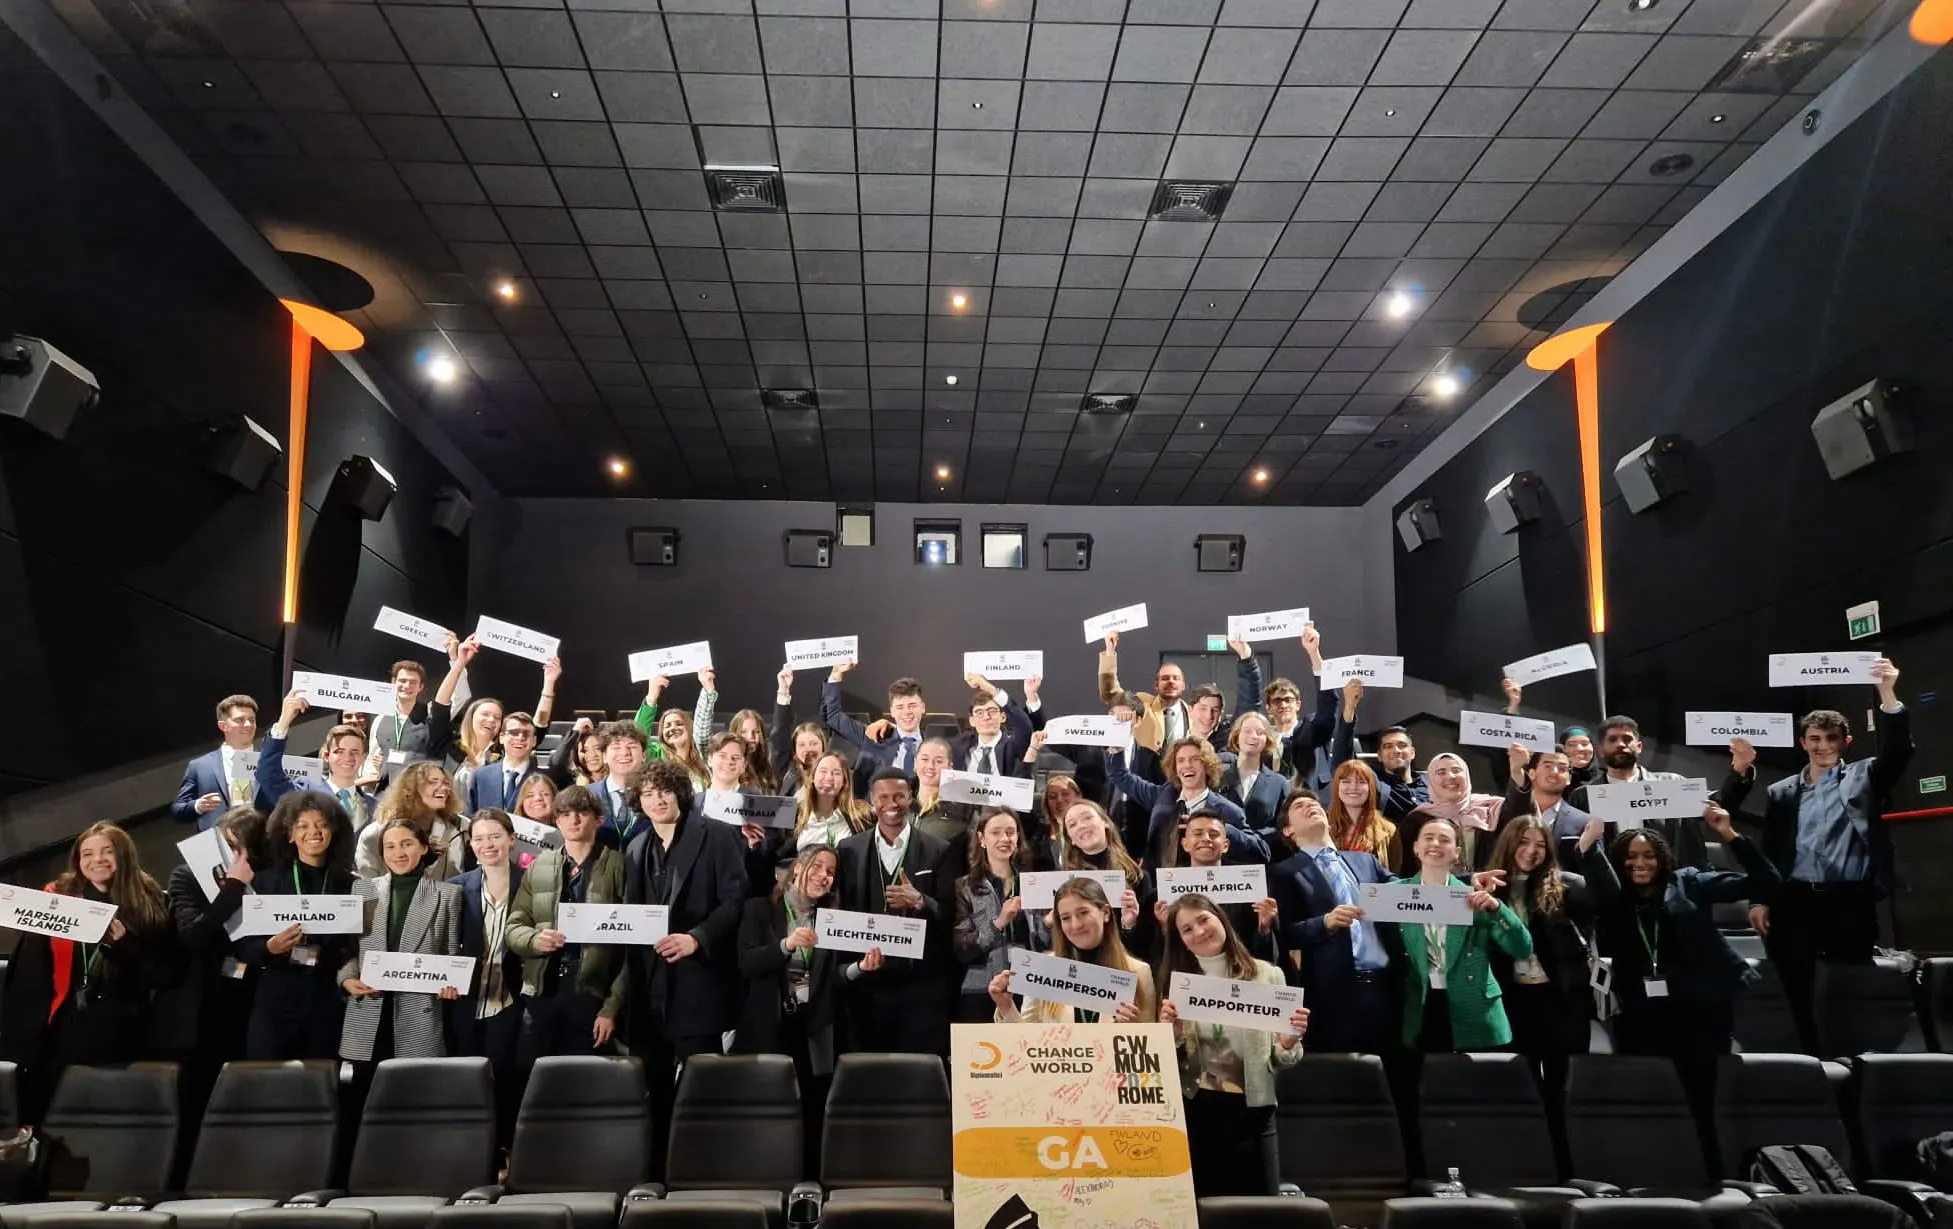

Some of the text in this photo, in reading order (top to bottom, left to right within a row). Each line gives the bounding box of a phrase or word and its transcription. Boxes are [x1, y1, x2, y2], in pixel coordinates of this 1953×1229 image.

[399, 623, 428, 639] GREECE
[1249, 623, 1288, 633] NORWAY
[791, 649, 854, 661] UNITED KINGDOM
[658, 659, 684, 669] SPAIN
[1341, 669, 1376, 678] FRANCE
[1800, 666, 1850, 676] AUSTRIA
[317, 688, 371, 703] BULGARIA
[1064, 728, 1105, 737] SWEDEN
[1479, 727, 1538, 742] COSTA RICA
[1711, 727, 1768, 737] COLOMBIA
[969, 786, 1003, 798] JAPAN
[1630, 798, 1669, 808] EGYPT
[724, 807, 776, 818] AUSTRALIA
[1171, 883, 1253, 894] SOUTH AFRICA
[1396, 902, 1434, 911] CHINA
[14, 907, 81, 928] MARSHALL
[273, 913, 336, 921] THAILAND
[16, 916, 70, 934] ISLANDS
[826, 928, 913, 945] LIECHTENSTEIN
[382, 970, 448, 982] ARGENTINA
[1025, 972, 1117, 1001] CHAIRPERSON
[1189, 996, 1281, 1017] RAPPORTEUR
[1113, 1035, 1148, 1055] CW
[1026, 1047, 1095, 1058] CHANGE
[1029, 1062, 1094, 1074] WORLD
[1114, 1054, 1161, 1073] MUN
[1116, 1073, 1163, 1088] 2023
[1118, 1087, 1165, 1105] ROME
[1037, 1135, 1109, 1170] GA
